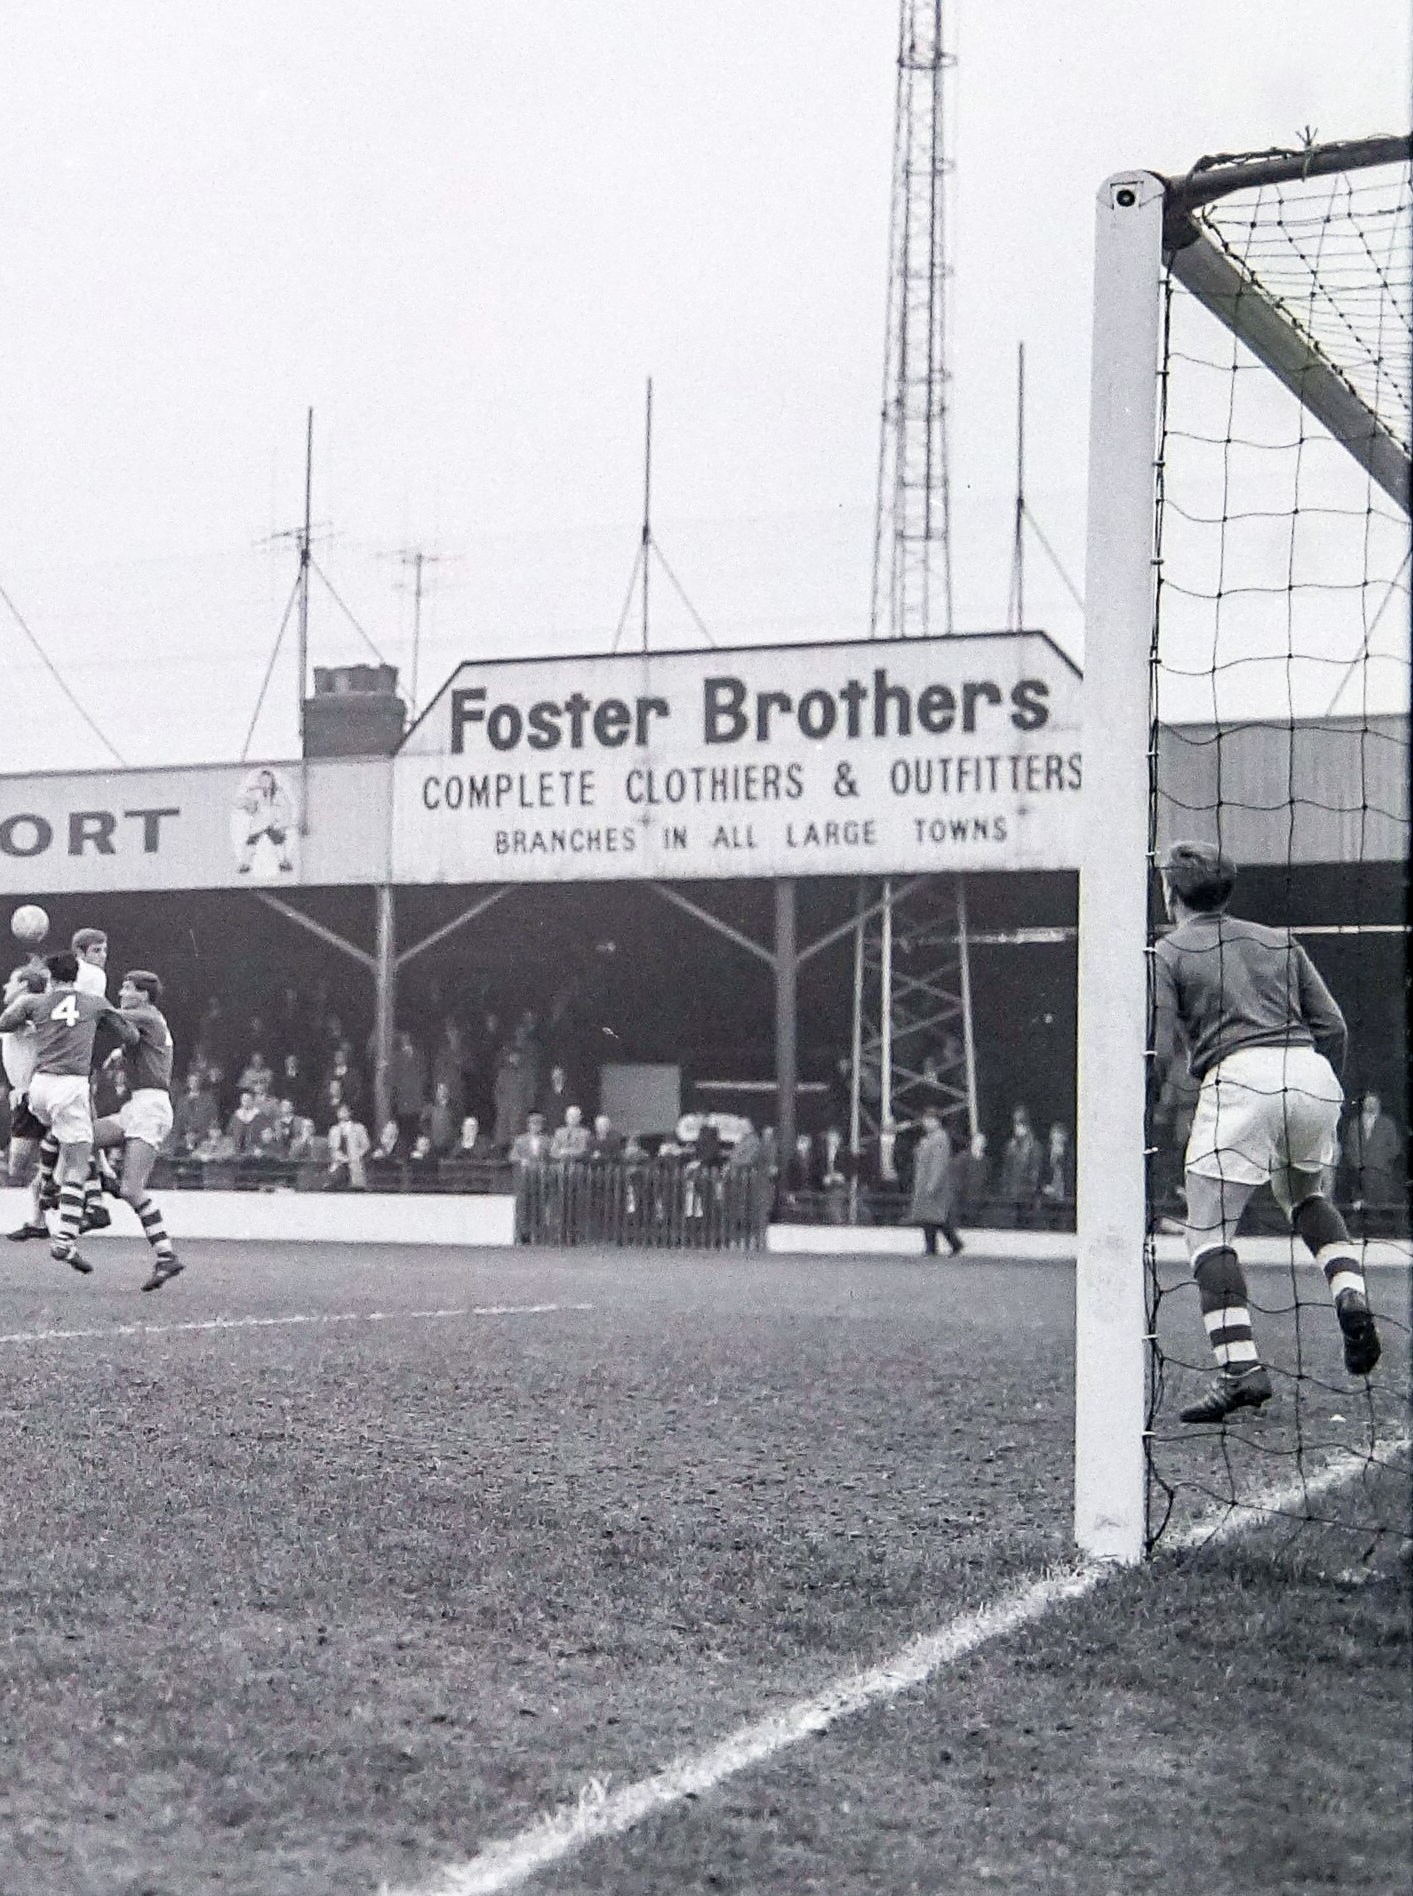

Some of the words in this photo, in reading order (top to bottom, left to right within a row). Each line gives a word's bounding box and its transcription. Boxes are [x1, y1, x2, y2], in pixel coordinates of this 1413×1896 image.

[451, 686, 670, 754] Foster
[704, 668, 1051, 745] Brothers
[423, 770, 595, 810] COMPLETE
[626, 762, 804, 805] CLOTHIERS
[834, 760, 859, 798] &
[890, 751, 1082, 796] OUTFITTERS
[495, 826, 636, 855] BRANCHES
[663, 825, 687, 850] IN
[712, 823, 757, 849] ALL
[786, 818, 877, 848] LARGE
[914, 815, 1007, 843] TOWNS
[50, 994, 81, 1028] 4
